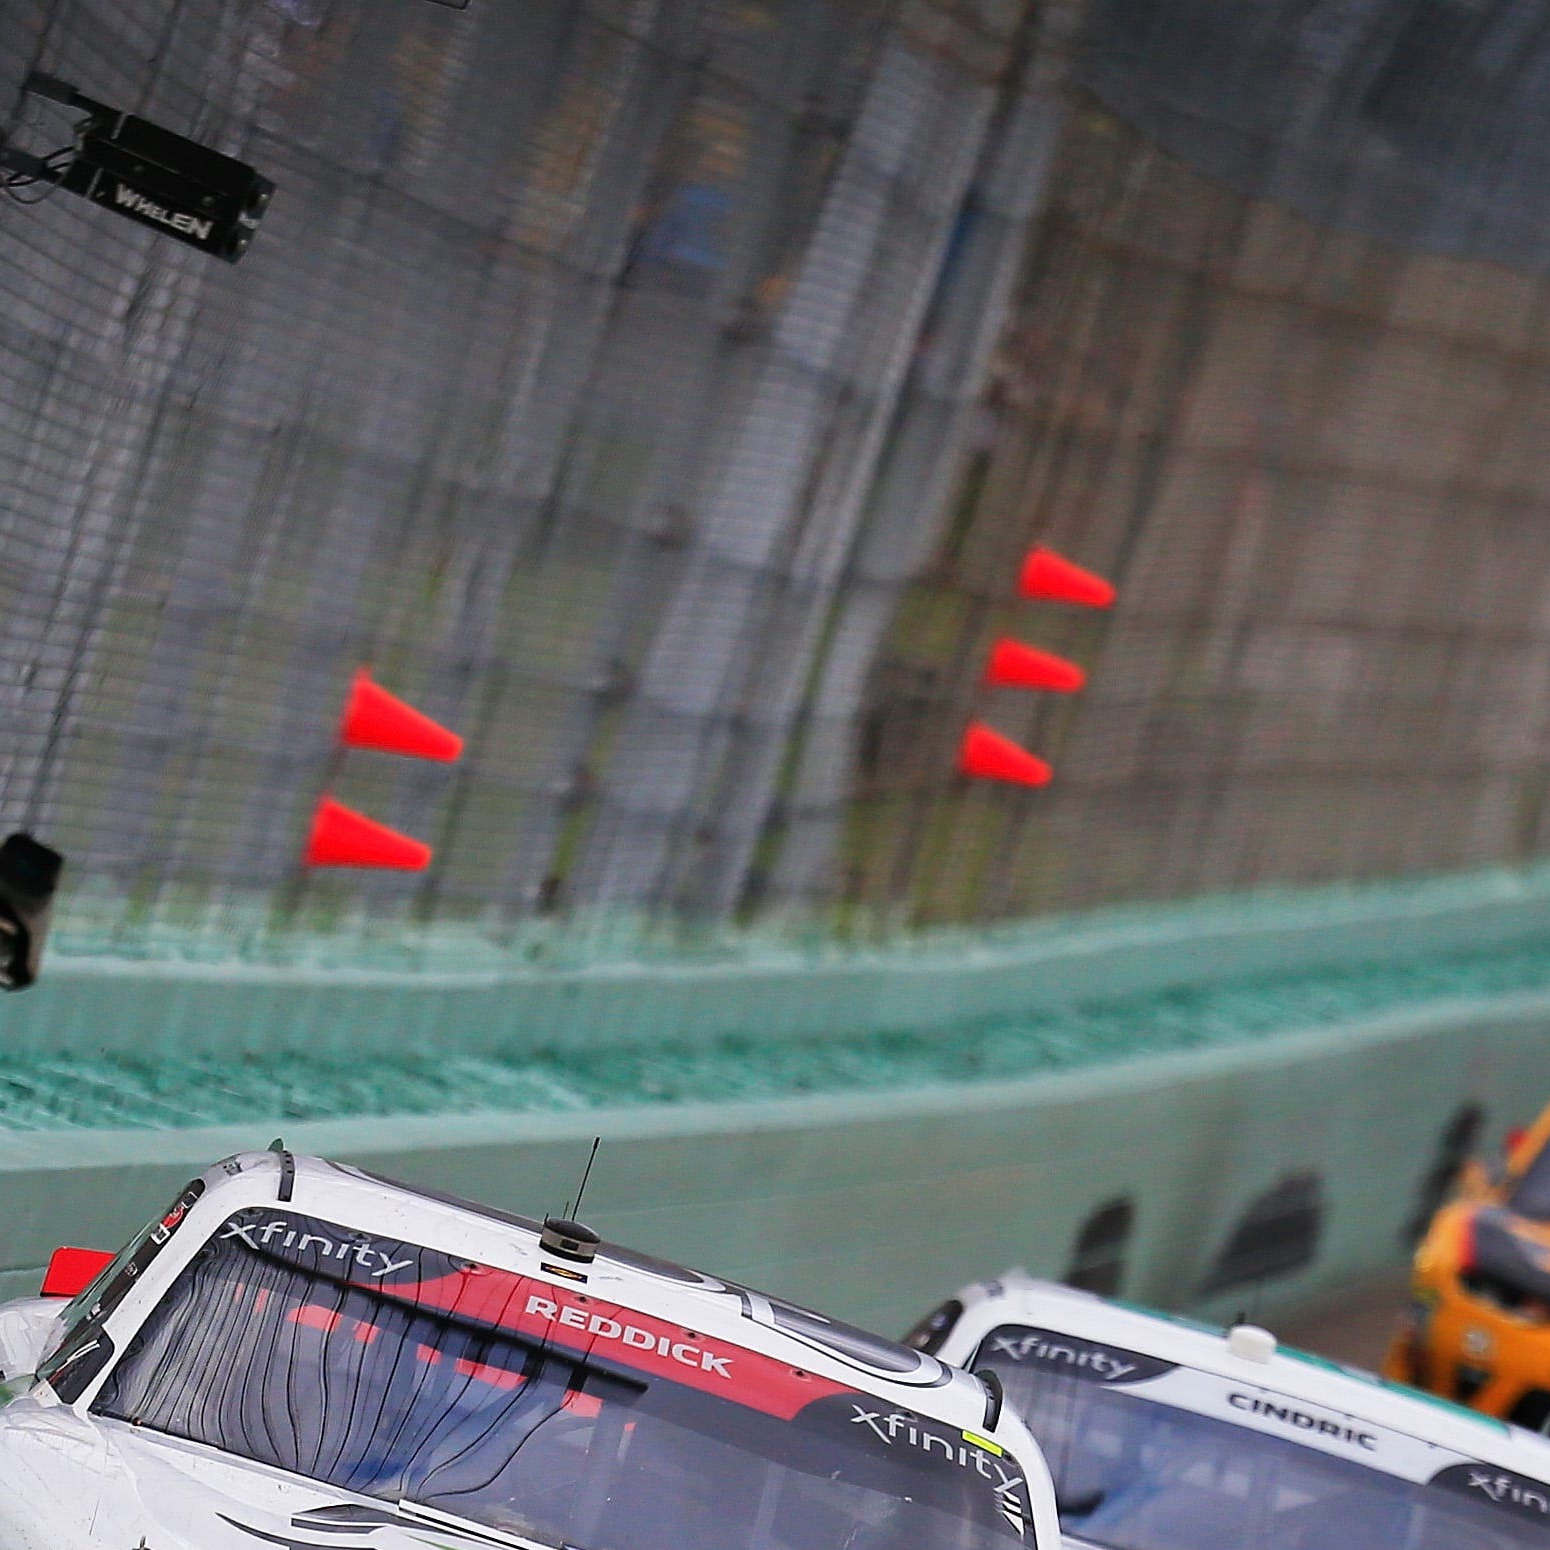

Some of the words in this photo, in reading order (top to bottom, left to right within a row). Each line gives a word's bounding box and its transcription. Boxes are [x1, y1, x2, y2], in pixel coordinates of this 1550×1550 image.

[115, 183, 215, 240] WHELEN
[219, 1221, 414, 1278] xfinity
[524, 1295, 735, 1380] REDDICK
[991, 1333, 1137, 1381] xfinity
[850, 1404, 1024, 1494] xfinity
[1226, 1392, 1379, 1452] CINDRIC
